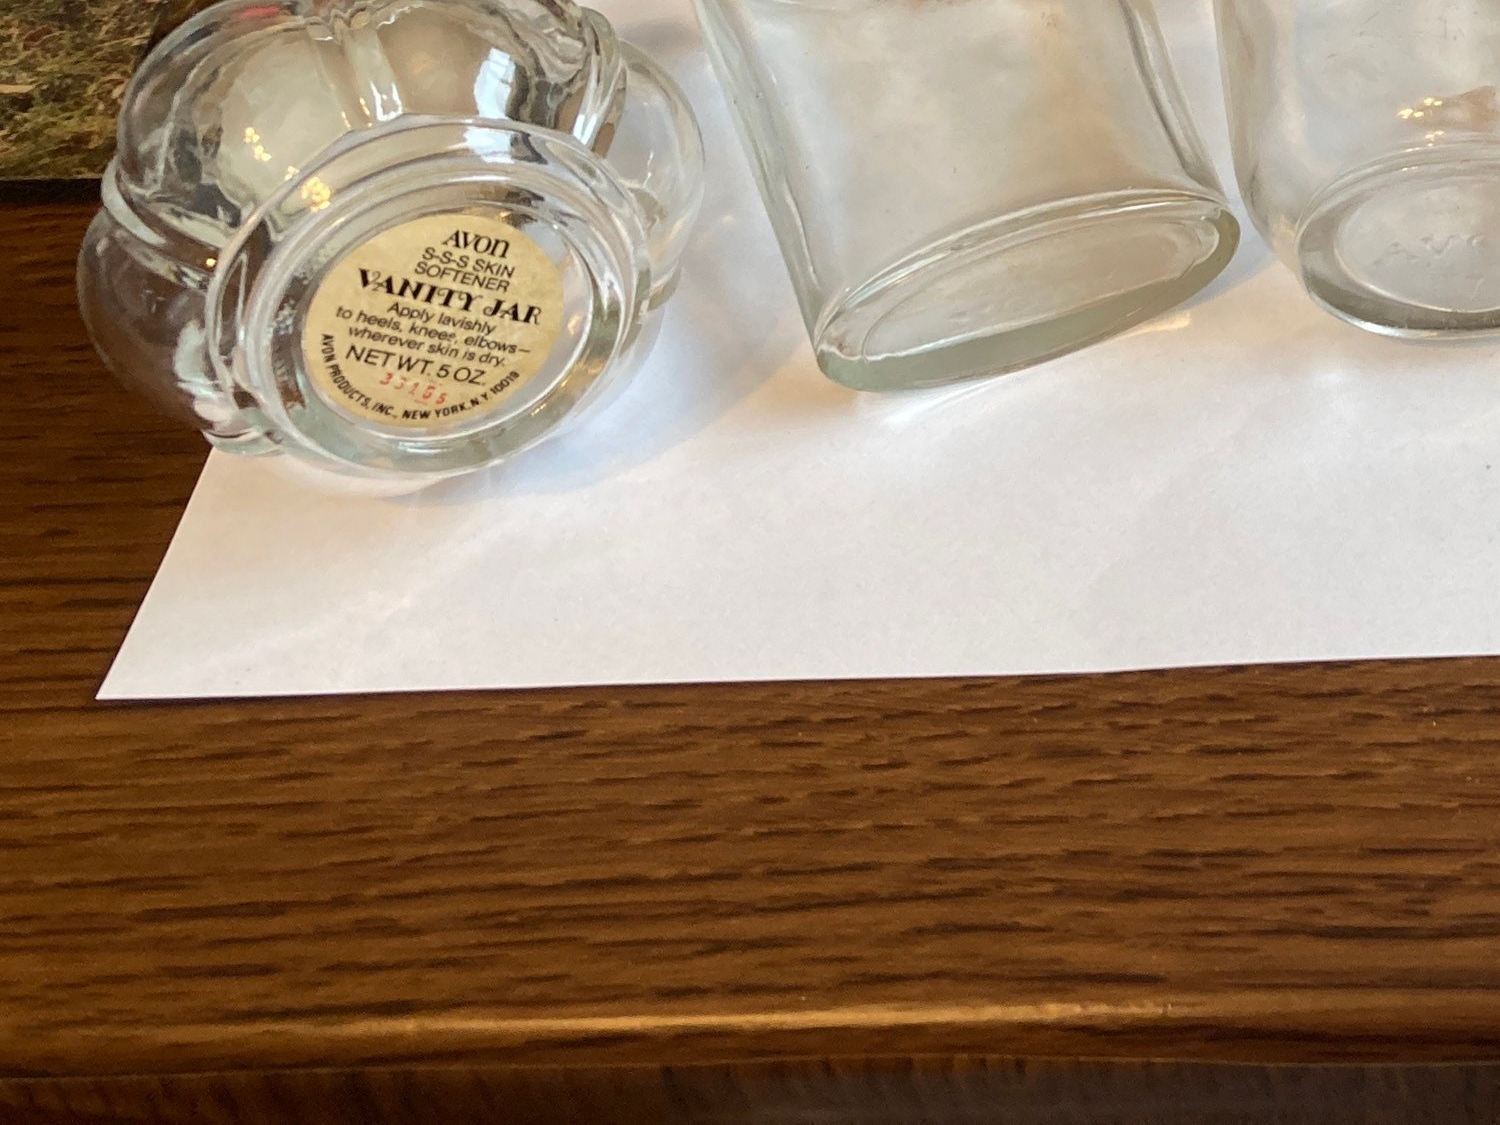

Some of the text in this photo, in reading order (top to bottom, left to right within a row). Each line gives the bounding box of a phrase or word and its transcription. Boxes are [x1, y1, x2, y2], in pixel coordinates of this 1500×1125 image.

[414, 261, 511, 293] SOFTENER
[422, 246, 516, 279] S-S-S SKIN
[336, 307, 352, 320] to
[358, 268, 543, 325] VANITY JAR
[387, 302, 497, 336] Apply lavishly
[348, 327, 425, 351] wherever
[428, 343, 459, 359] skin
[463, 349, 475, 361] is
[321, 333, 338, 363] AVON
[402, 409, 431, 420] NEW
[345, 345, 487, 386] NET WT. 5 OZ.
